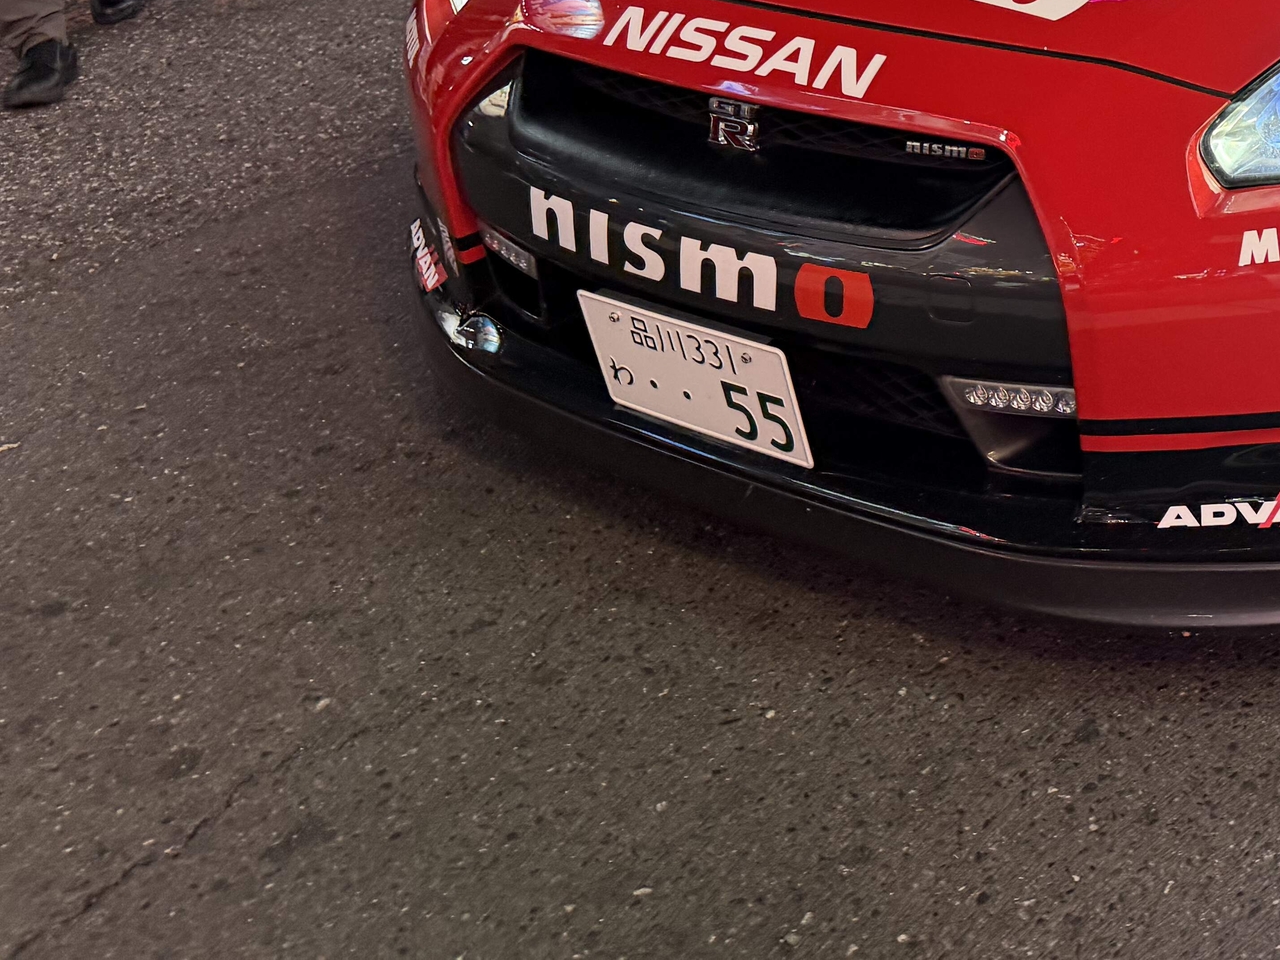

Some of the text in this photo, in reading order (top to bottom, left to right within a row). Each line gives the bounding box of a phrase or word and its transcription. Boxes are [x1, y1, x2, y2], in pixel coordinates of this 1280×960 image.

[602, 5, 887, 100] NISSAN
[709, 113, 761, 153] R
[905, 139, 986, 161] nismo
[410, 218, 440, 289] ADVAN
[530, 185, 875, 329] nismo
